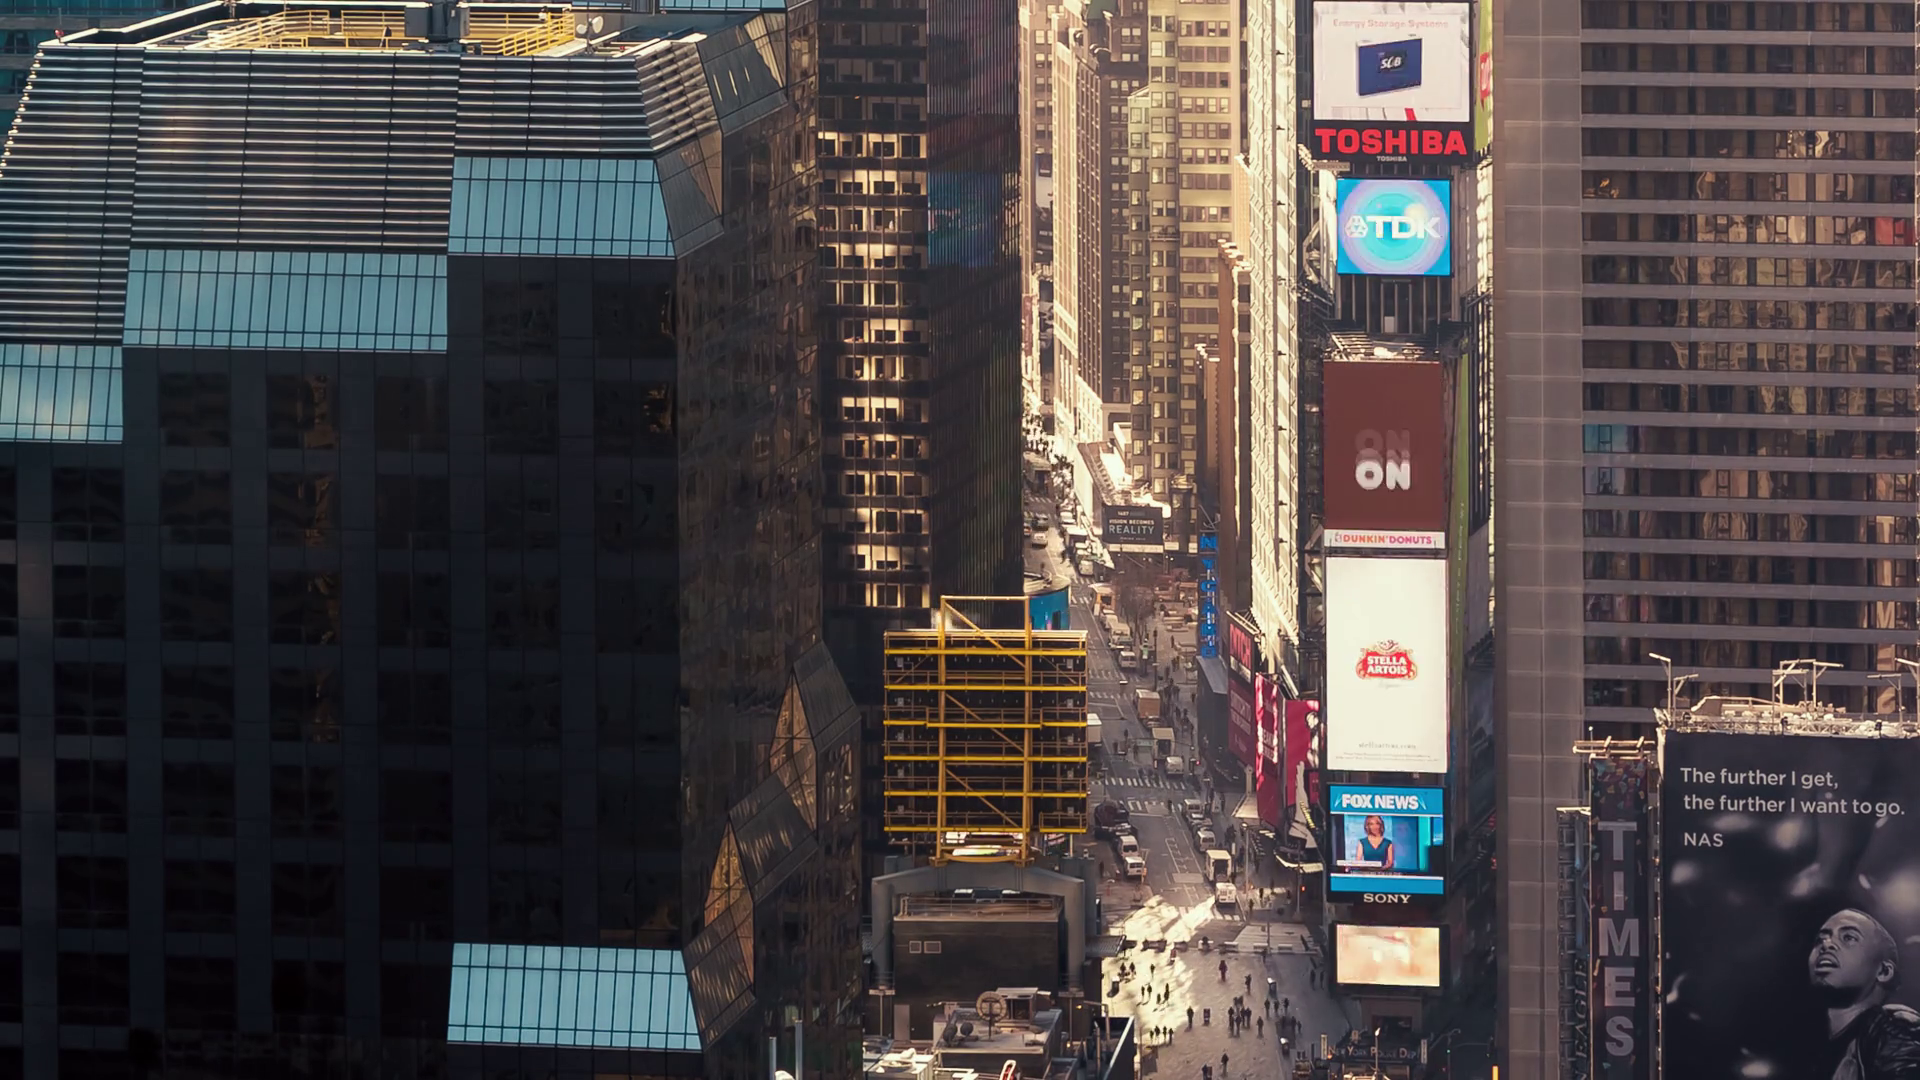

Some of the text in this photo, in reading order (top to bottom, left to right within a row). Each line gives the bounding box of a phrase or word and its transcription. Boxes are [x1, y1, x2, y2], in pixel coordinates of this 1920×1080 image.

[1333, 19, 1449, 29] Energy Storage Systems
[1315, 128, 1467, 155] TOSHIBA
[1366, 215, 1441, 238] TDK
[1355, 461, 1410, 490] ON
[1109, 525, 1155, 534] REALITY
[1343, 534, 1432, 545] DUNKIN' DONUTS
[1367, 655, 1407, 665] STELLA
[1367, 664, 1408, 674] ARTOIS
[1680, 767, 1839, 789] The further I get,
[1341, 794, 1419, 810] FOX NEWS
[1683, 794, 1906, 818] the further I want to go.
[1683, 832, 1724, 847] NAS
[1363, 893, 1411, 903] SONY
[1597, 821, 1640, 1057] TIMES
[1574, 959, 1588, 1058] EAGLE
